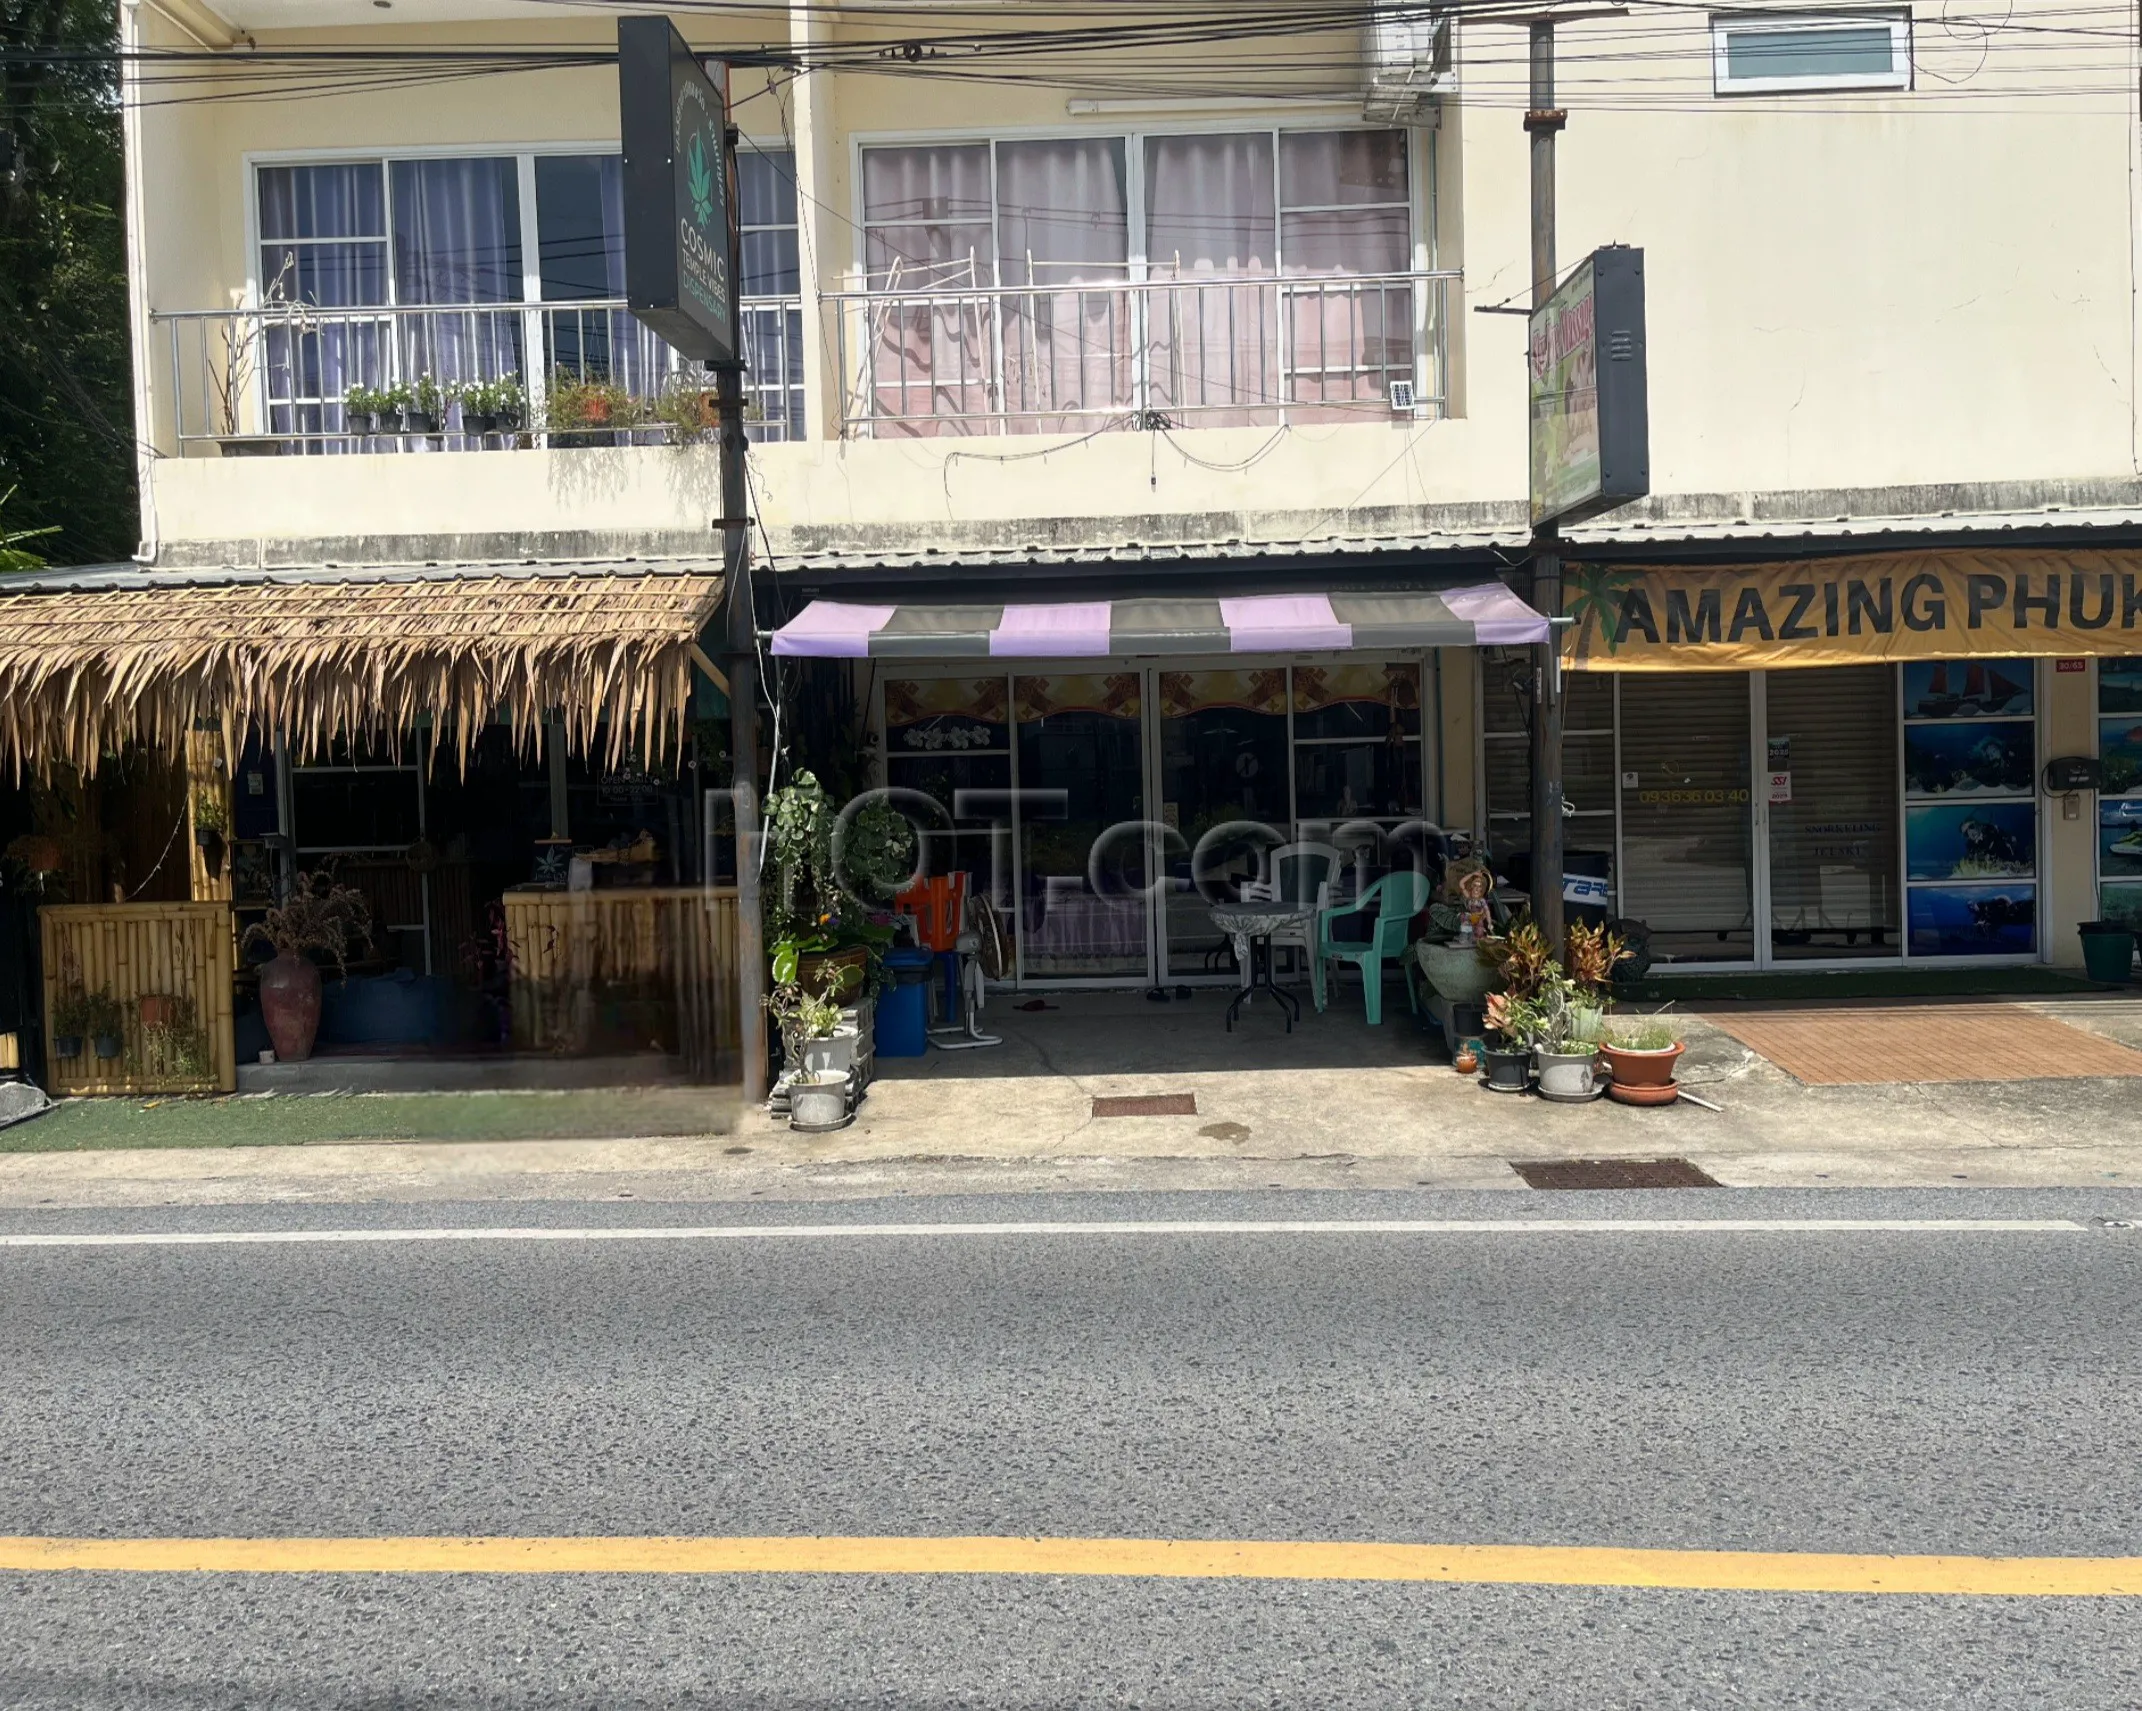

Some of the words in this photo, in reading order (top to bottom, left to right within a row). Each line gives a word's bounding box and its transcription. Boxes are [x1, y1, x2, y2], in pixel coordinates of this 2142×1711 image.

[681, 217, 725, 282] COSMIC
[682, 247, 707, 286] TEMPLE
[683, 270, 726, 325] DISPENSARY
[1613, 572, 1944, 643] AMAZING
